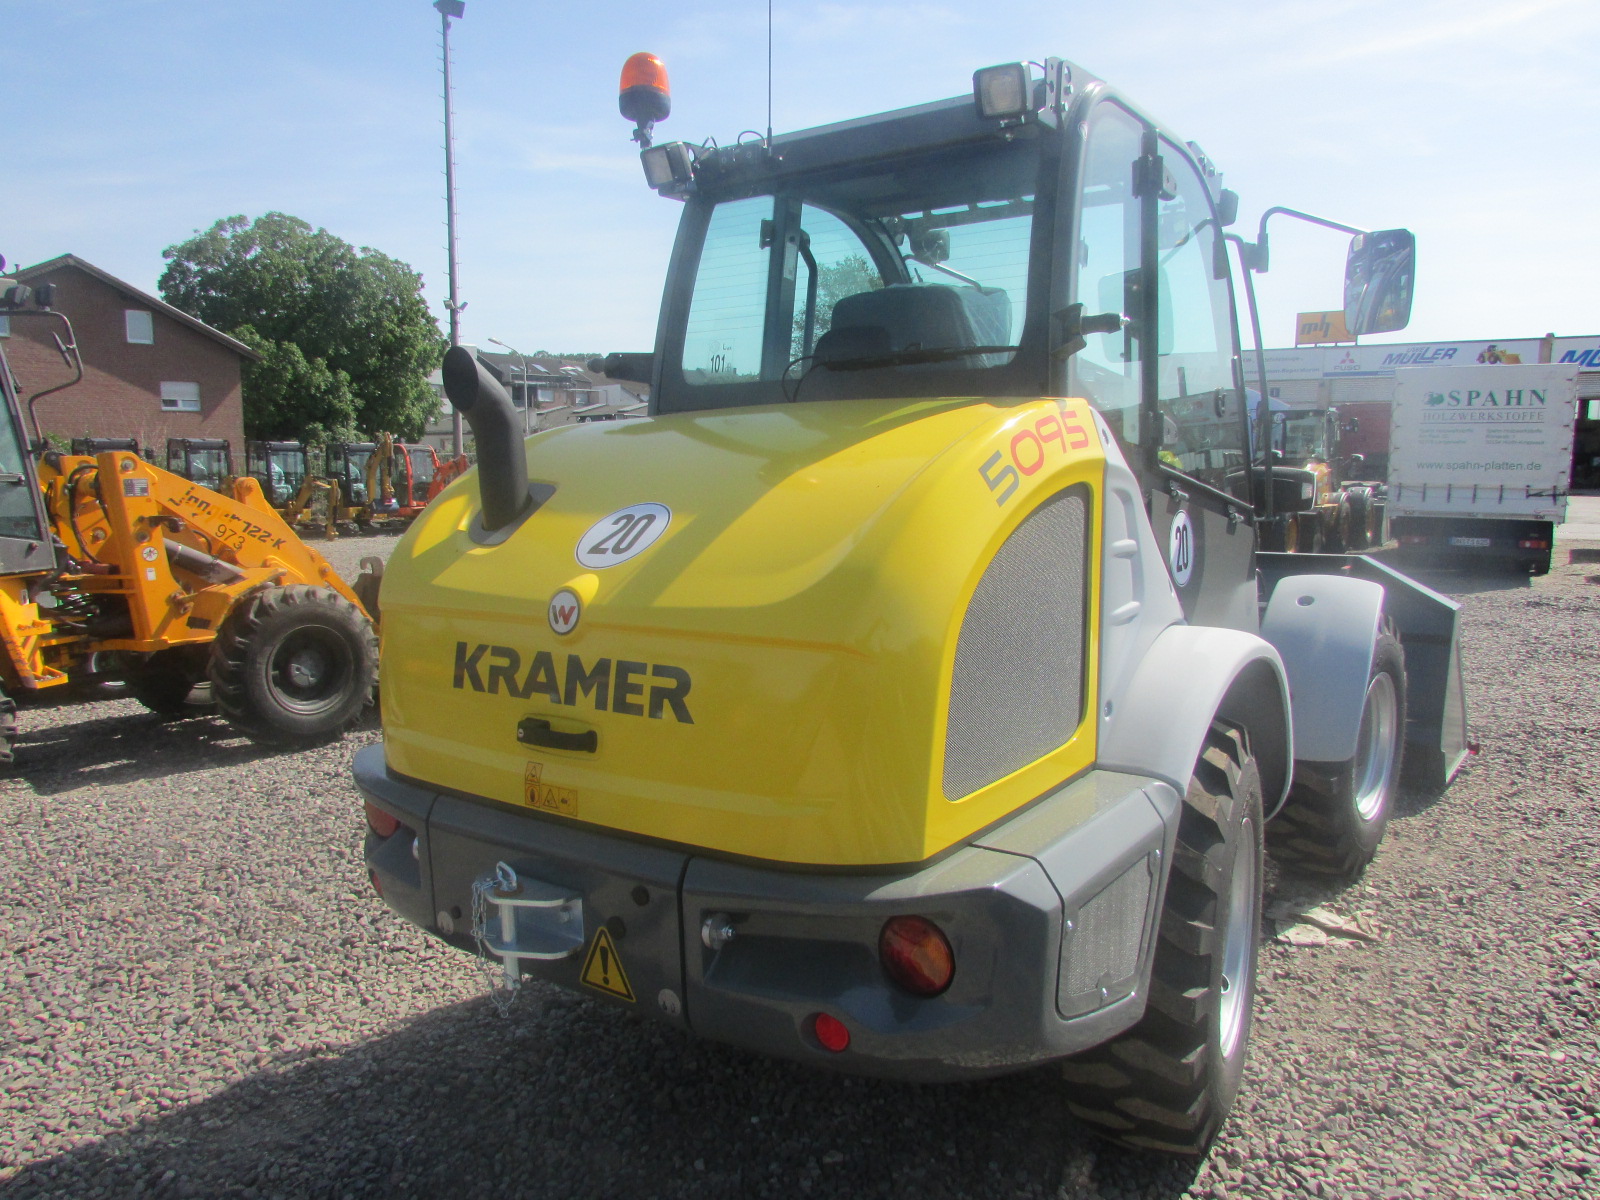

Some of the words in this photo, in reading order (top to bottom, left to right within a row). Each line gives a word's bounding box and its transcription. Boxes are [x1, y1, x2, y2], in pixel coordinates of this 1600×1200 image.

[711, 354, 726, 373] 101
[1447, 389, 1548, 407] SPAHN
[1423, 411, 1545, 422] HOLZWERKSTOFFE
[978, 410, 1089, 508] 5095
[1416, 461, 1542, 472] www.spahn-platten.de
[215, 524, 246, 550] 973
[586, 513, 657, 555] 20
[1175, 523, 1189, 573] 20
[453, 641, 695, 725] KRAMER
